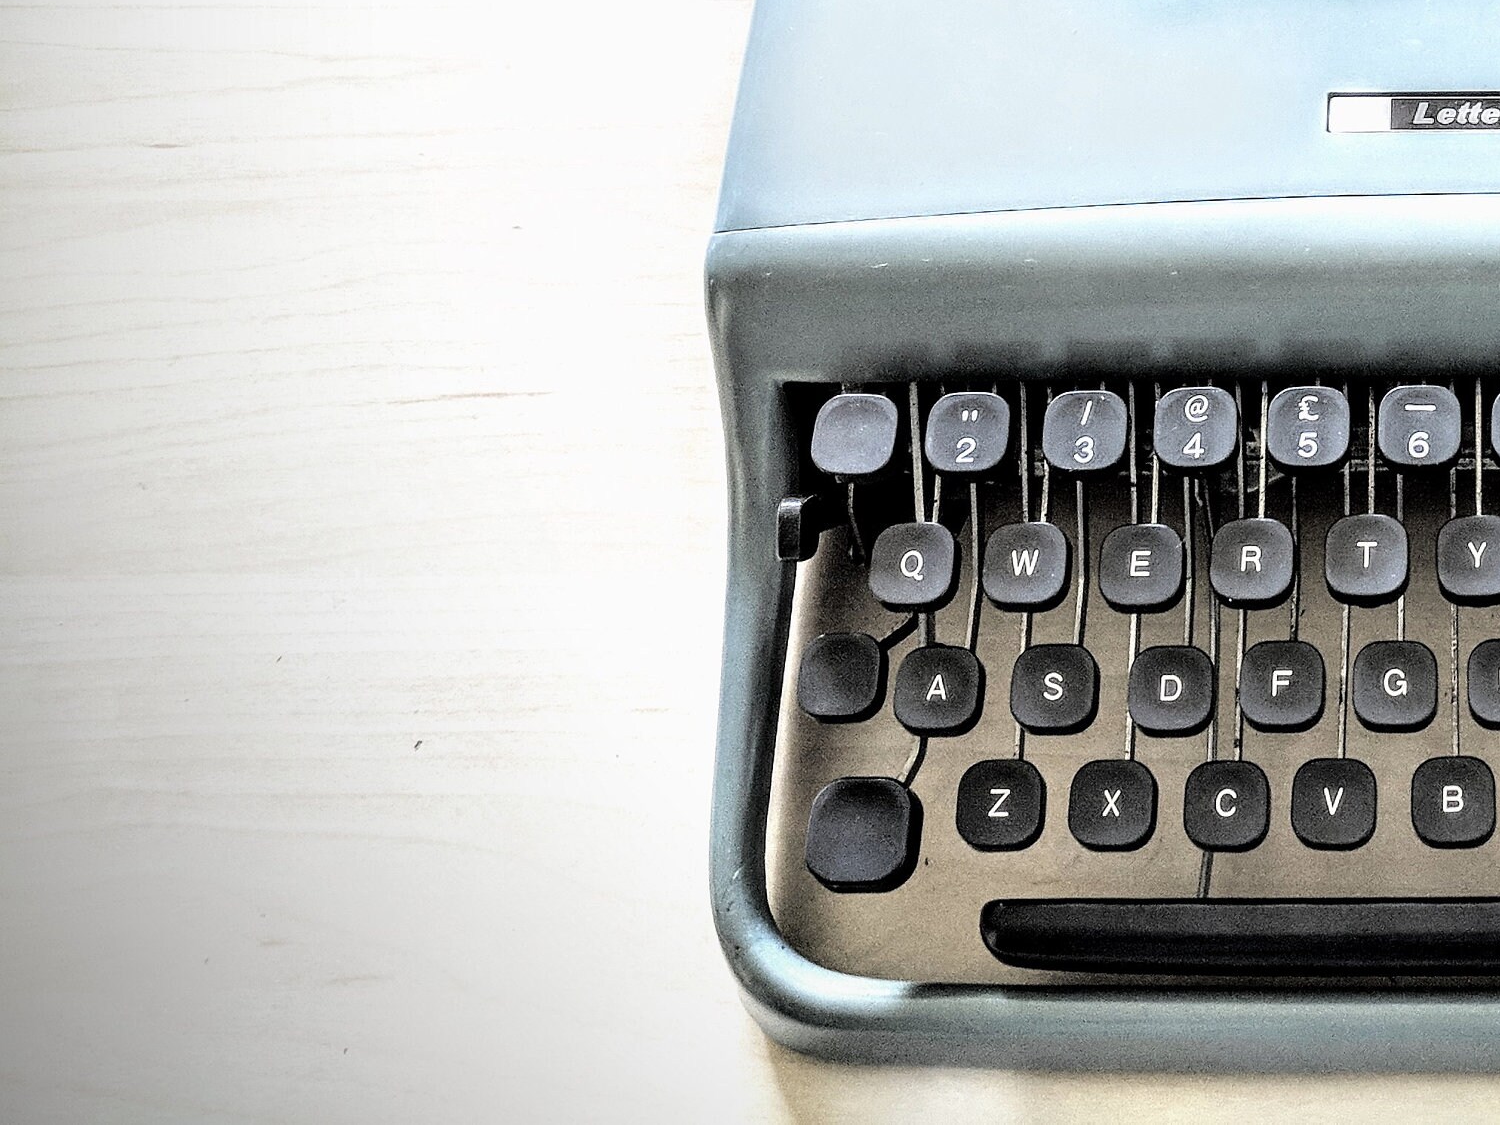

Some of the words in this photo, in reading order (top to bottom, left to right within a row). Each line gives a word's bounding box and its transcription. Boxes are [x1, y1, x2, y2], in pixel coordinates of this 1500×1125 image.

[1184, 394, 1209, 423] @
[1298, 395, 1320, 422] £
[955, 437, 977, 464] 2
[1073, 435, 1094, 464] 3
[1182, 432, 1205, 459] 4
[1298, 431, 1320, 458] 5
[1408, 431, 1430, 459] 6
[900, 550, 924, 581] Q
[1011, 549, 1039, 578] W
[1129, 550, 1152, 577] E
[1240, 545, 1262, 572] R
[1356, 541, 1378, 569] T
[1467, 541, 1487, 568] Y
[926, 674, 947, 701] A
[1043, 672, 1063, 701] S
[1159, 674, 1183, 702] D
[1271, 669, 1293, 697] F
[1383, 668, 1408, 697] G
[987, 788, 1011, 818] Z
[1102, 789, 1121, 817] X
[1215, 788, 1237, 817] C
[1323, 787, 1344, 816] V
[1442, 785, 1464, 813] B
